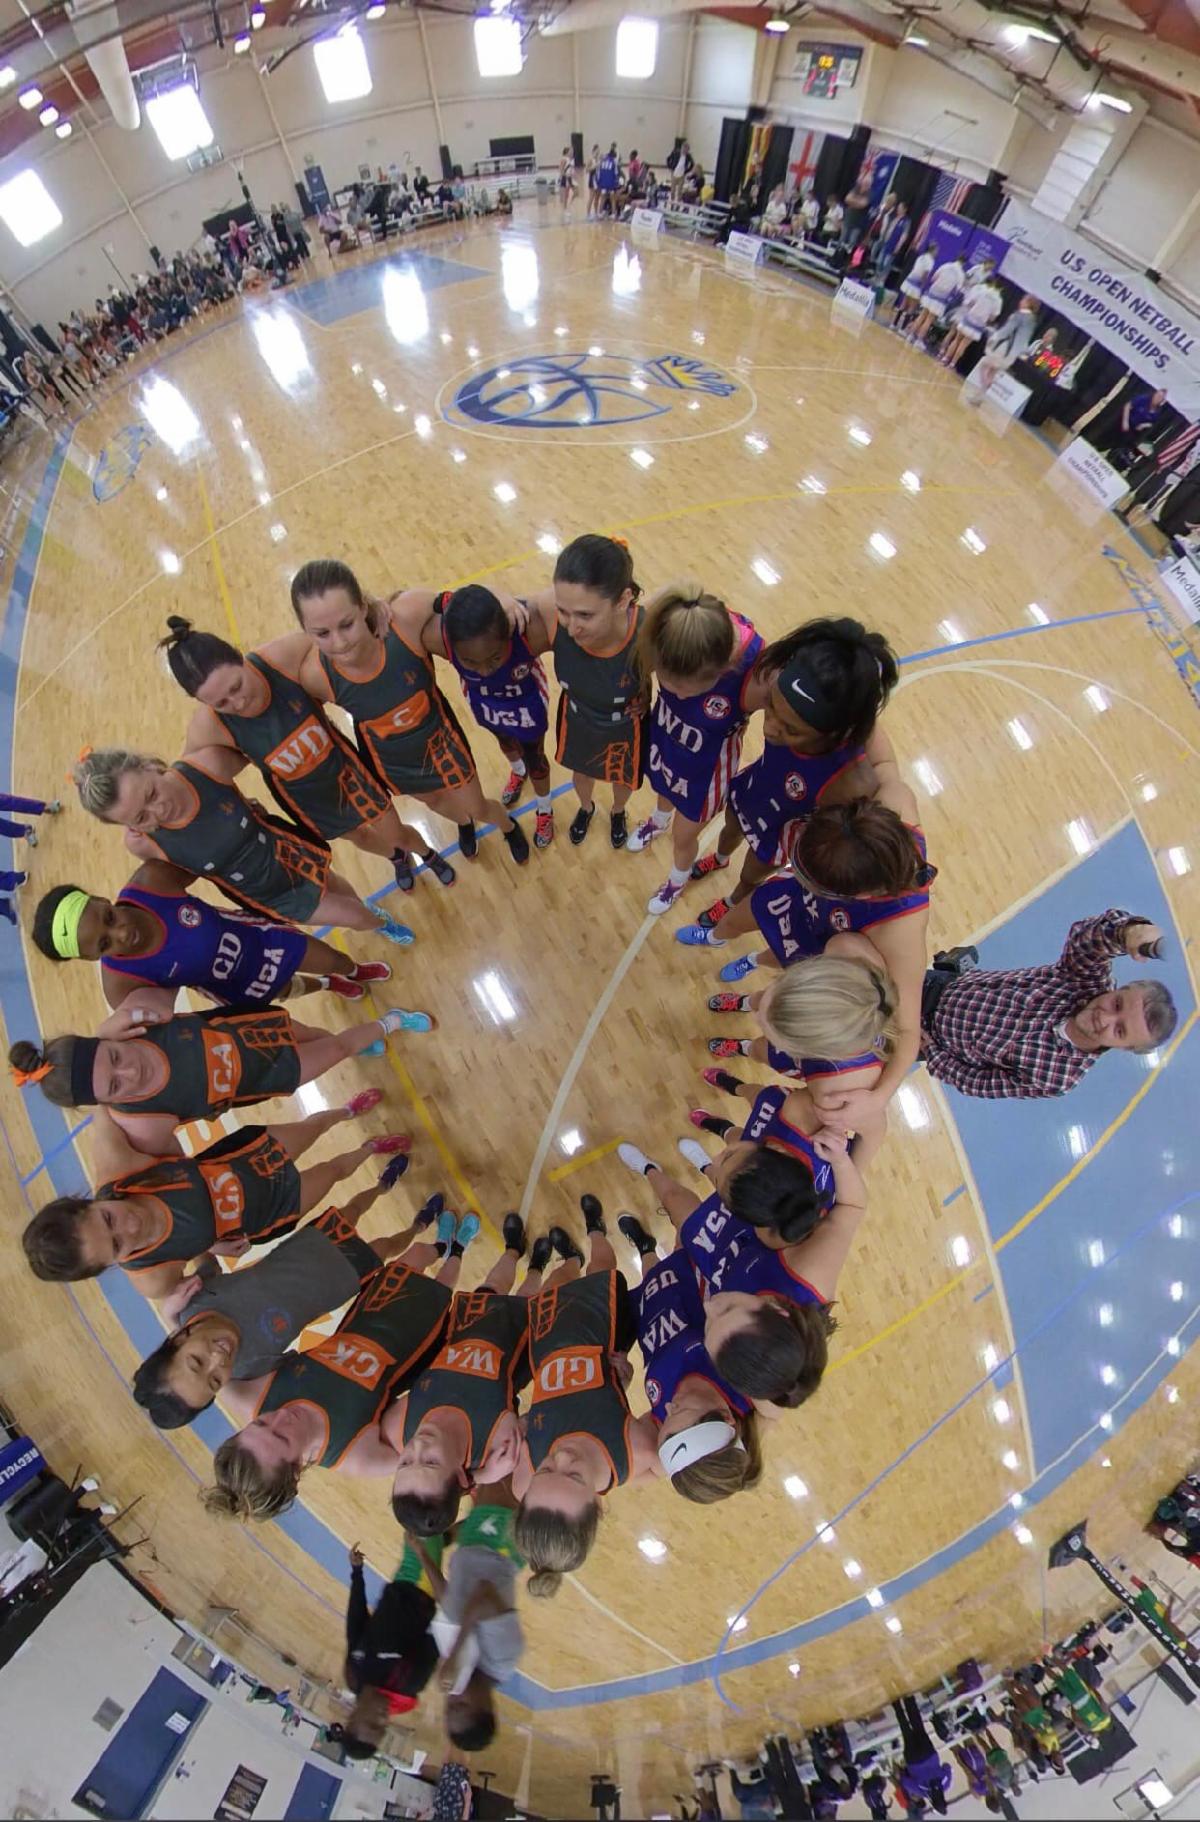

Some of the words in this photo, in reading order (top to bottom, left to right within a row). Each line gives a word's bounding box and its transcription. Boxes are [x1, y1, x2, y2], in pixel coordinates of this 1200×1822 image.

[1088, 268, 1133, 304] OPEN
[1128, 297, 1195, 356] NETBALL
[656, 695, 703, 753] WD
[269, 725, 330, 774] WD
[767, 894, 800, 958] USA
[212, 932, 241, 979] GD
[244, 949, 285, 998] USA
[640, 1270, 679, 1316] US
[642, 1308, 688, 1353] WA
[320, 1339, 381, 1379] GK
[540, 1356, 595, 1392] GD
